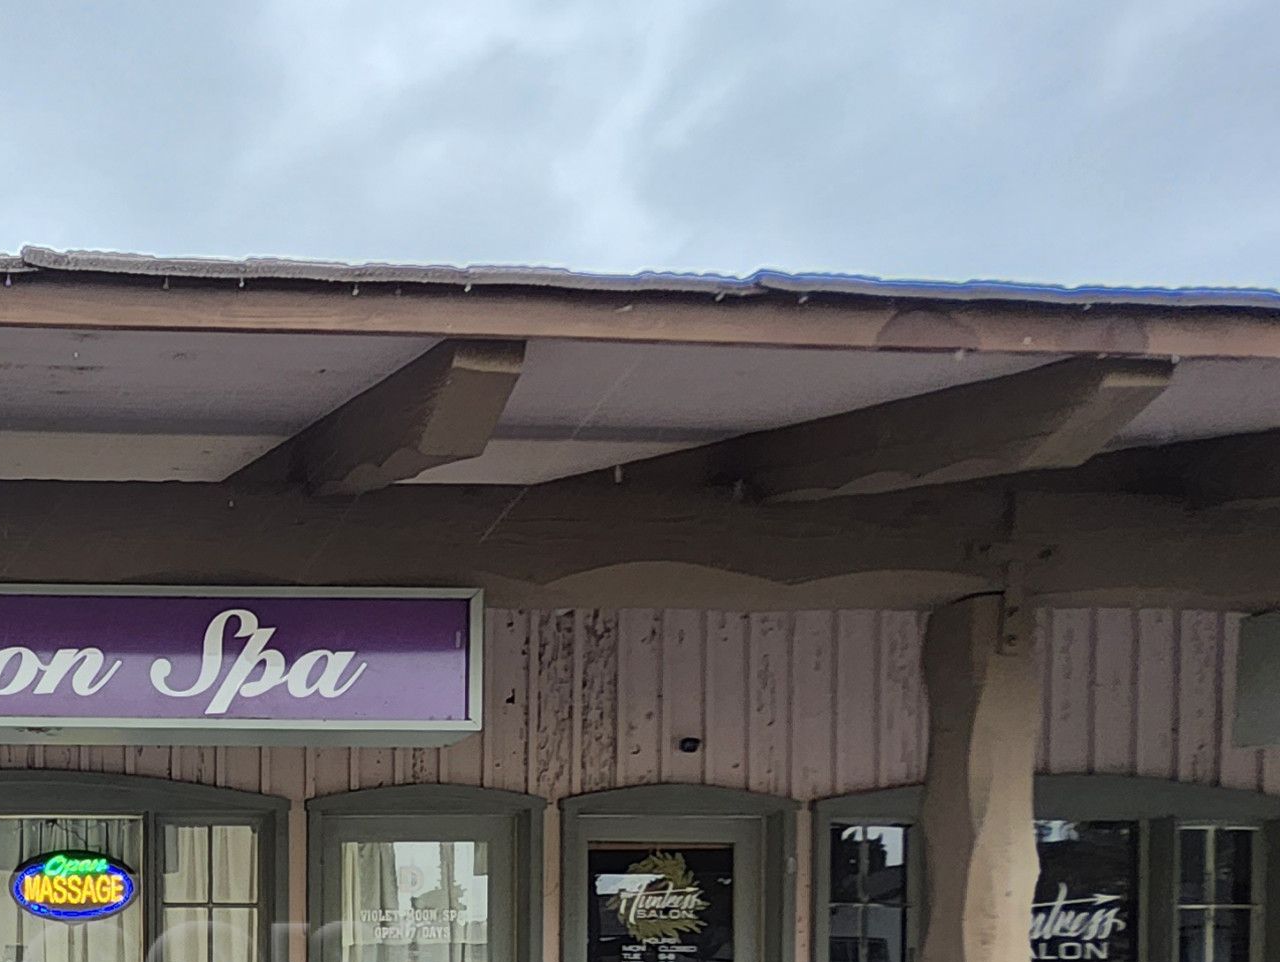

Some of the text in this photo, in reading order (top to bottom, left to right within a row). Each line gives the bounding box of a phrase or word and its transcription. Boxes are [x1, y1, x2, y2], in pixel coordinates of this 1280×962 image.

[151, 608, 367, 713] Spa
[44, 854, 107, 877] Open
[24, 875, 124, 904] MASSAGE
[637, 909, 696, 919] SALON
[1030, 942, 1109, 960] LON
